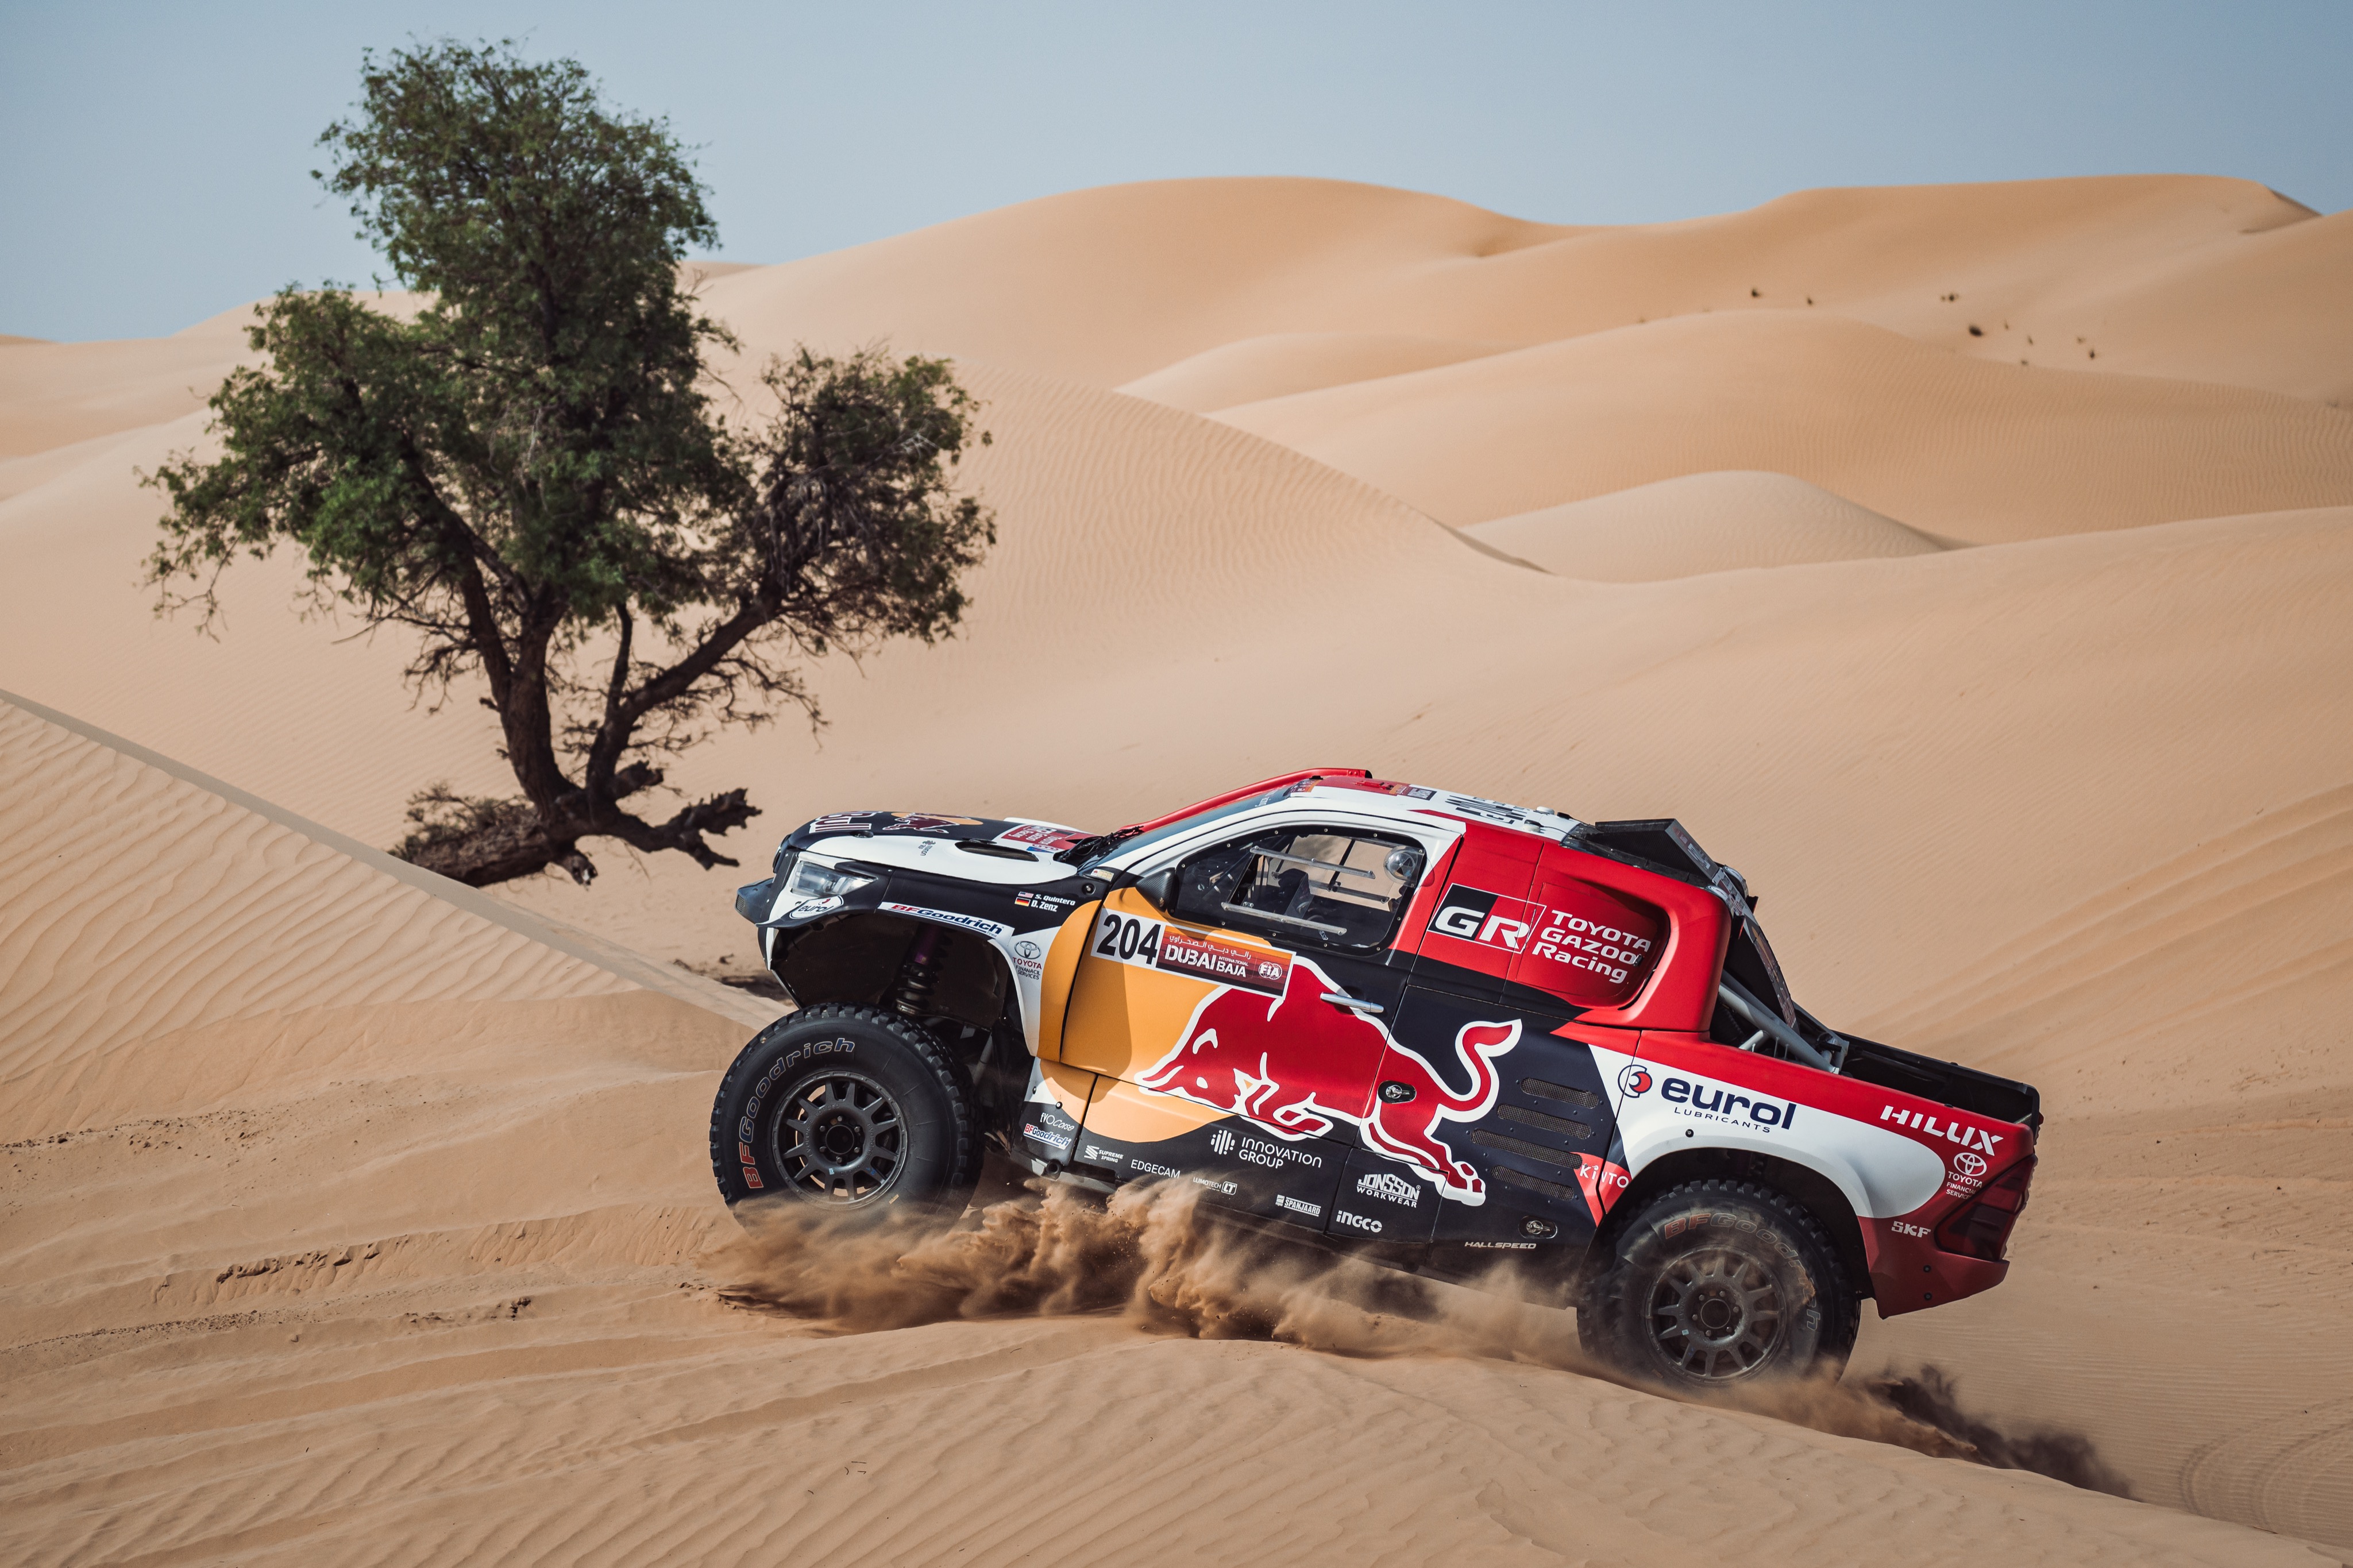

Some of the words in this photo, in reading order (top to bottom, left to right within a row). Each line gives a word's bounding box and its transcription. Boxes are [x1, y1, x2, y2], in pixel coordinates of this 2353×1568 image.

[1031, 899, 1039, 908] D.
[1039, 901, 1058, 912] Zenz
[1043, 895, 1076, 906] Quintero
[890, 904, 1003, 935] BFGoodrich
[1435, 906, 1530, 949] GR
[1096, 914, 1162, 965] 204
[1551, 909, 1652, 952] TOYOTA
[1540, 927, 1637, 965] GAZOO
[1013, 957, 1042, 970] TOYOTA
[1164, 944, 1217, 970] DUBAI
[1218, 956, 1249, 967] INTERNATIONAL
[1532, 942, 1628, 984] Racing
[1018, 970, 1039, 980] SERVICES
[1216, 960, 1247, 978] BAJA
[739, 1037, 856, 1189] BFGoodrich
[1661, 1077, 1797, 1130] eurol
[1675, 1106, 1770, 1133] LUBRICANTS
[1025, 1124, 1069, 1146] BFGoodrich
[1880, 1105, 2004, 1156] HILUX
[1098, 1149, 1124, 1159] SUPREME
[1239, 1149, 1284, 1169] GROUP
[1241, 1137, 1322, 1168] INNOVATION
[1131, 1159, 1181, 1179] EDGECAM
[1948, 1171, 1982, 1188] TOYOTA
[1193, 1177, 1221, 1189] LUMOTECH
[1284, 1199, 1321, 1215] SPANJAARD
[1356, 1186, 1417, 1208] WORKWEAR
[1891, 1221, 1931, 1238] SKF
[1464, 1241, 1537, 1249] HALLSPEED
